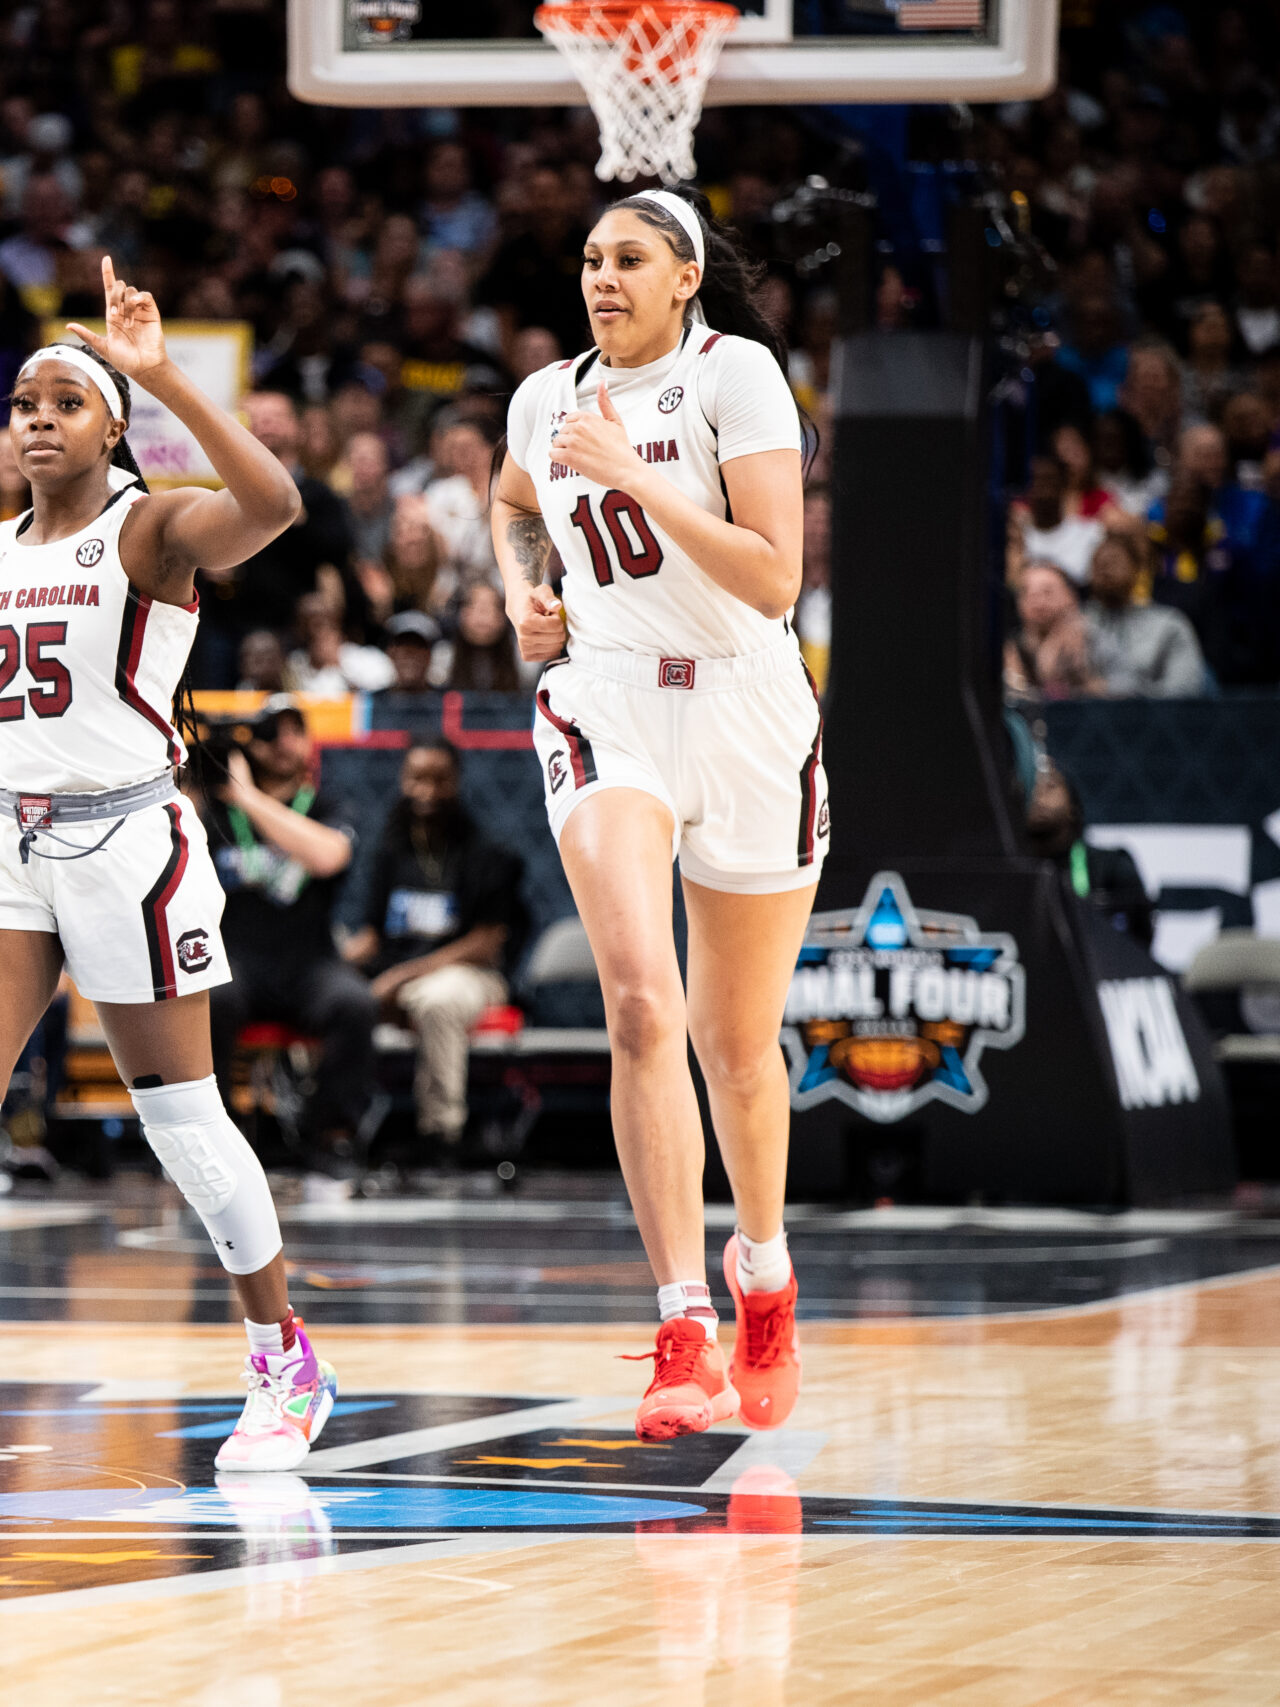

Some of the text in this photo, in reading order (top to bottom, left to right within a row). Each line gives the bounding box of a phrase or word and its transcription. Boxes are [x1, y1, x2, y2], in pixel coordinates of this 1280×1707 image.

[659, 387, 683, 412] SEC
[570, 489, 664, 587] 10
[77, 540, 105, 566] SEC
[15, 585, 100, 608] CAROLINA
[782, 965, 885, 1021] INAL
